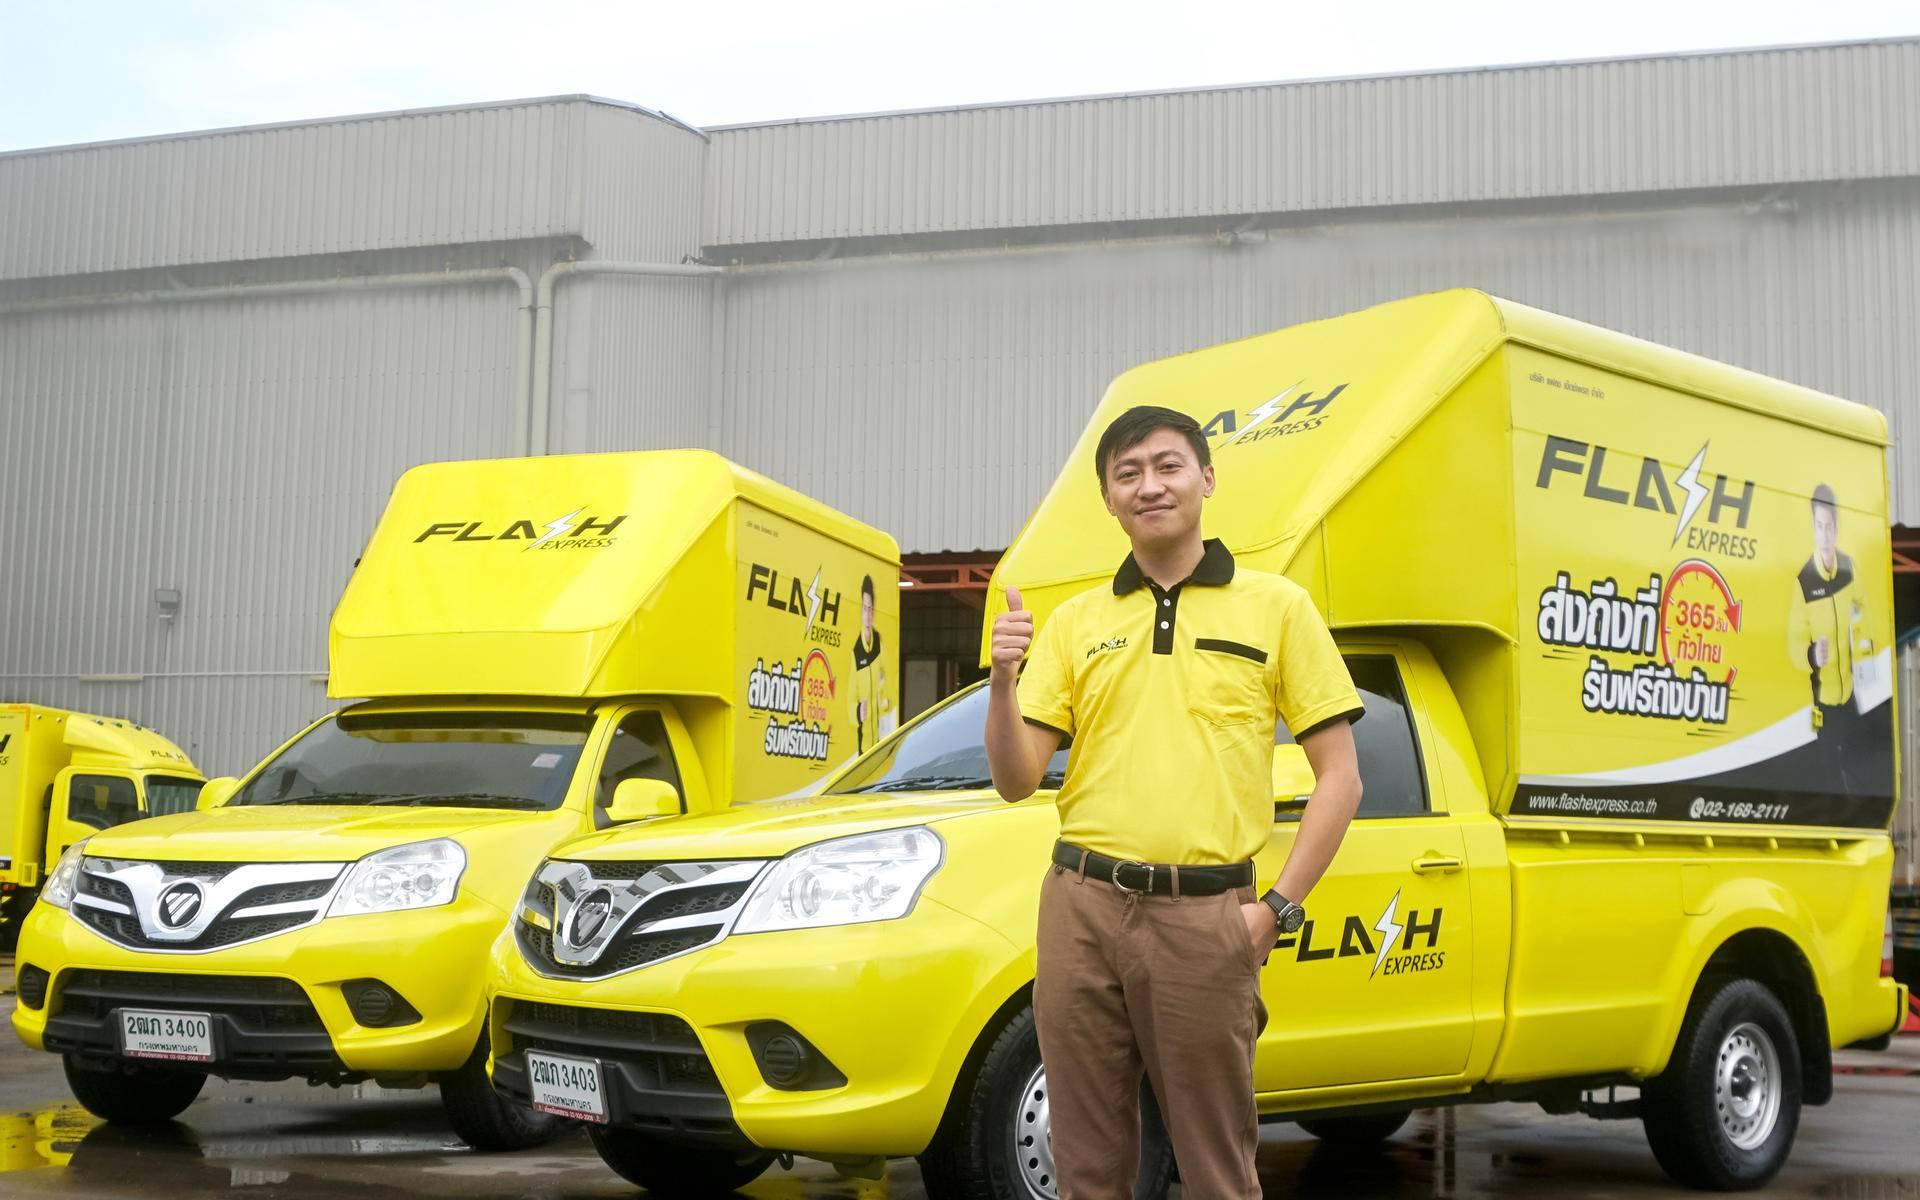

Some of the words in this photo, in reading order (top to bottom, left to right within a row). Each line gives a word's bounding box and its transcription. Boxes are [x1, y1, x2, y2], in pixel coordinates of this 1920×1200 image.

[1200, 381, 1349, 449] ASH
[1235, 416, 1328, 445] EXPRESS
[1536, 434, 1755, 545] FLASH
[413, 506, 628, 551] FLASH
[1687, 527, 1758, 560] EXPRESS
[540, 537, 618, 551] EXPRESS
[747, 563, 841, 638] FLASH
[1538, 572, 1661, 656] ส่งถึงที่
[1675, 600, 1716, 630] 365
[811, 625, 841, 648] EXPRESS
[1677, 629, 1722, 664] ทั่วไทย
[748, 658, 802, 715] ส่งถึงที่
[807, 678, 825, 698] 365
[1582, 655, 1729, 723] รับฟรีถึงบ้าน
[1529, 793, 1658, 815] www.flashexpress.co.th
[1703, 801, 1789, 820] 02-168-2111
[1383, 952, 1445, 976] EXPRESS
[165, 1019, 206, 1039] 3400
[562, 1064, 596, 1093] 3403
